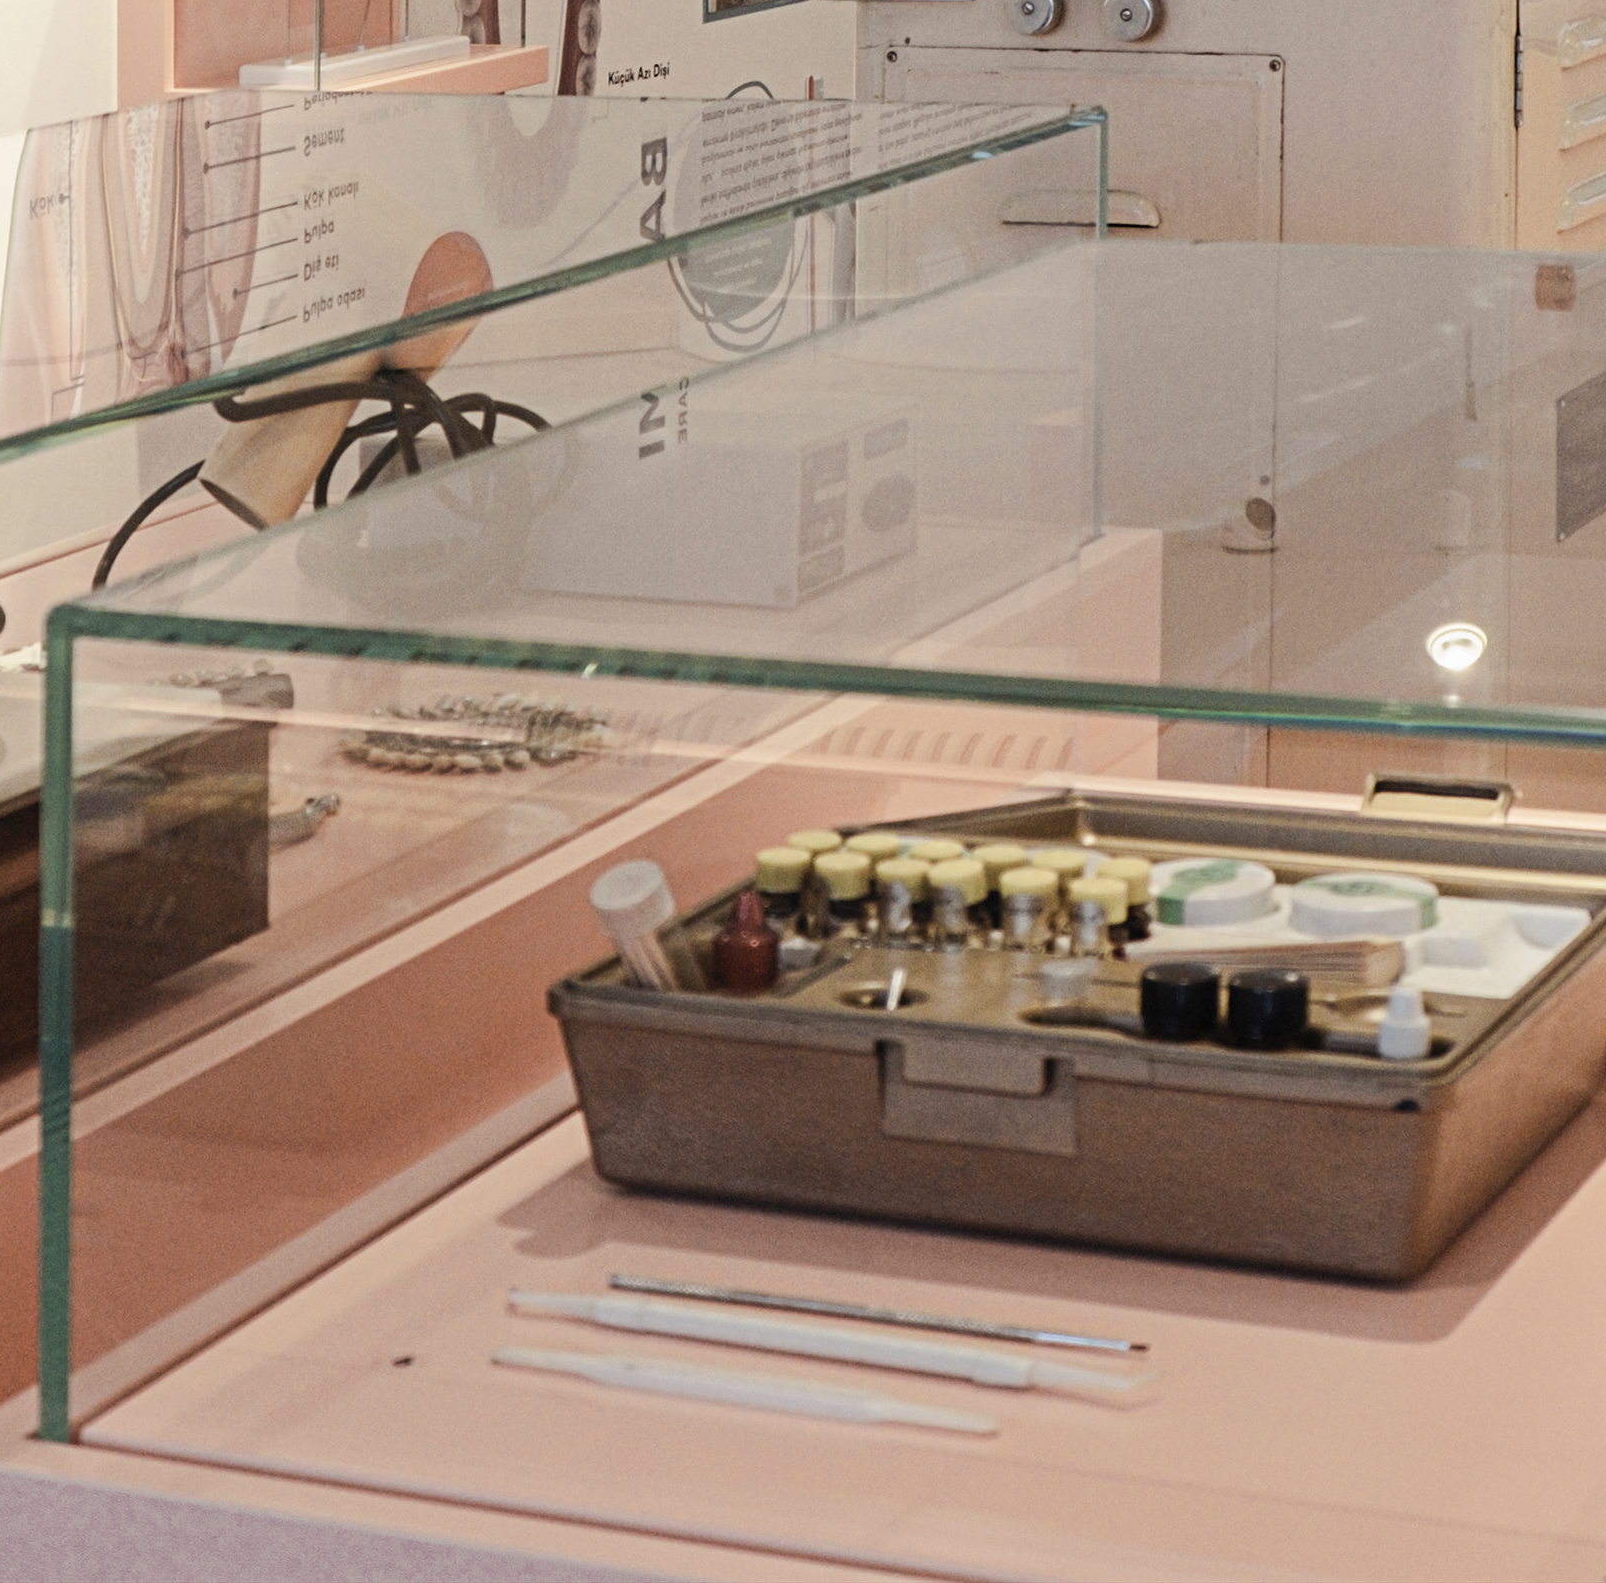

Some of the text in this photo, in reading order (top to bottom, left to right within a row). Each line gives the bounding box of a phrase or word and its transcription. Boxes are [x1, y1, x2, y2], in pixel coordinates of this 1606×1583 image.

[607, 62, 670, 87] Küçük Azı Dişi
